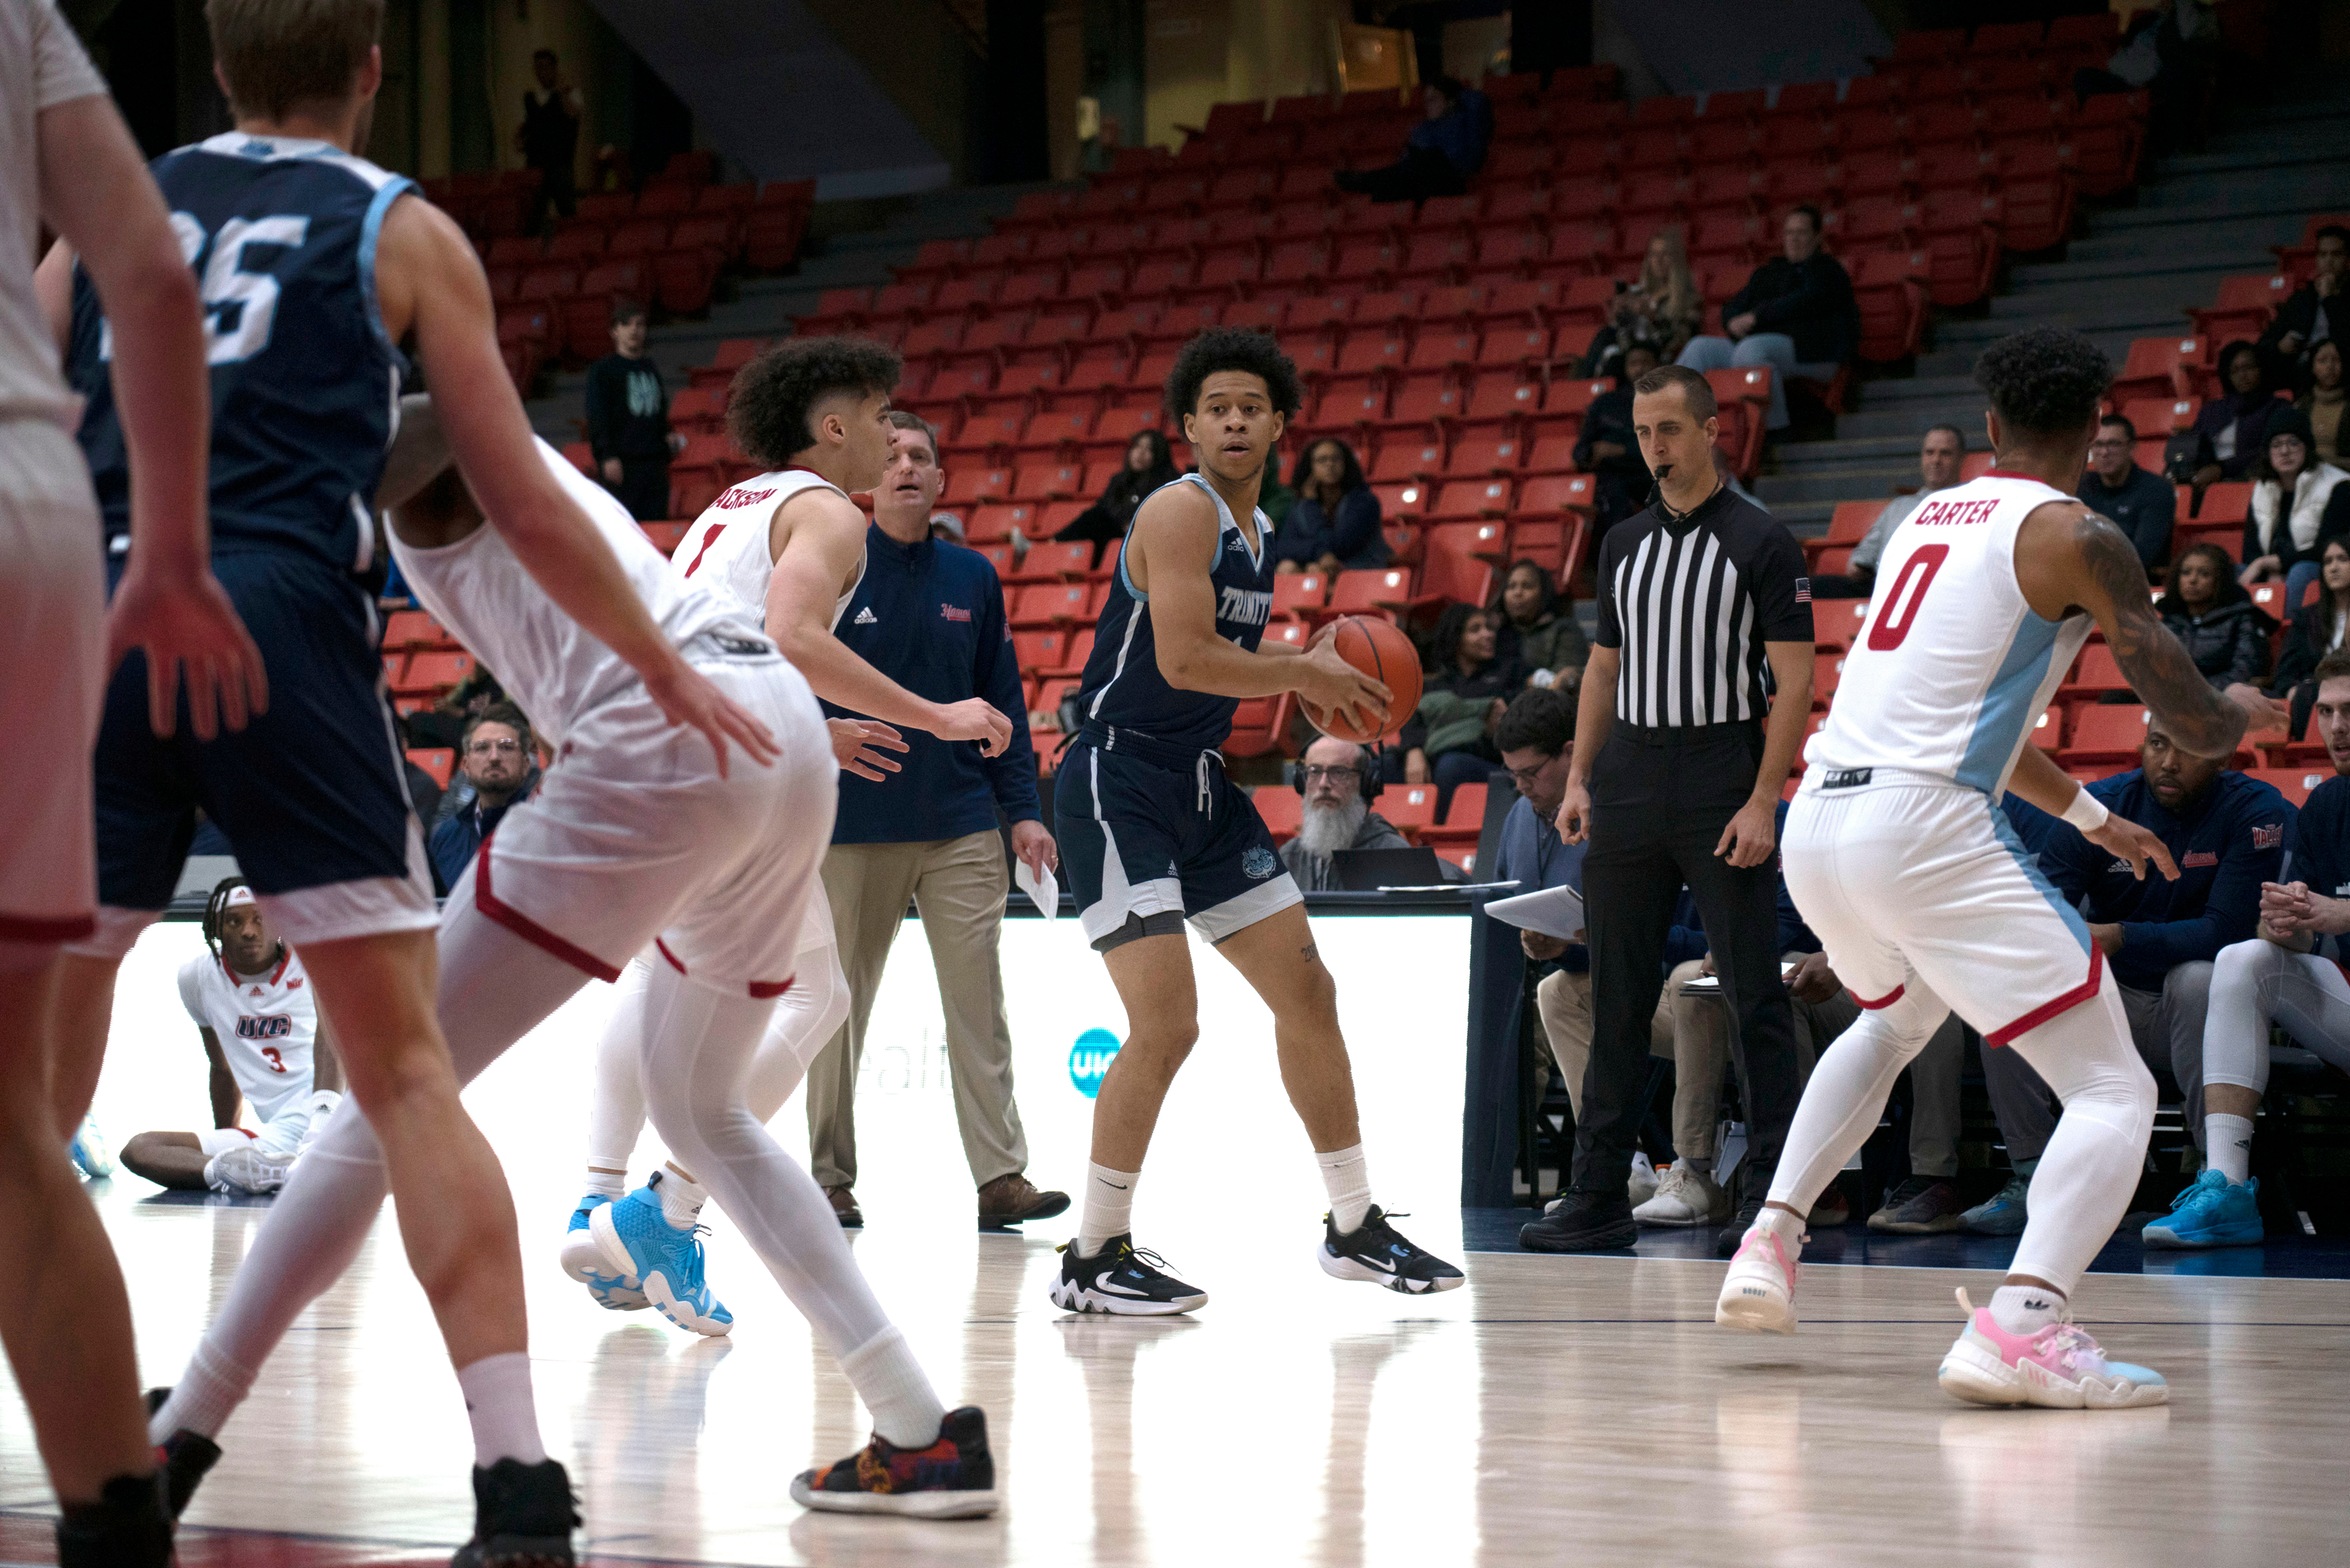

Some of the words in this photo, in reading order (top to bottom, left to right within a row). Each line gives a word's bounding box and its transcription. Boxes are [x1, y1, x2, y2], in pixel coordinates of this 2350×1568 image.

[706, 488, 779, 510] ACKSON
[1914, 498, 2001, 526] CARTER
[683, 523, 728, 580] 1
[1867, 543, 1950, 652] 0
[235, 1013, 292, 1040] UIC
[261, 1046, 288, 1074] 3
